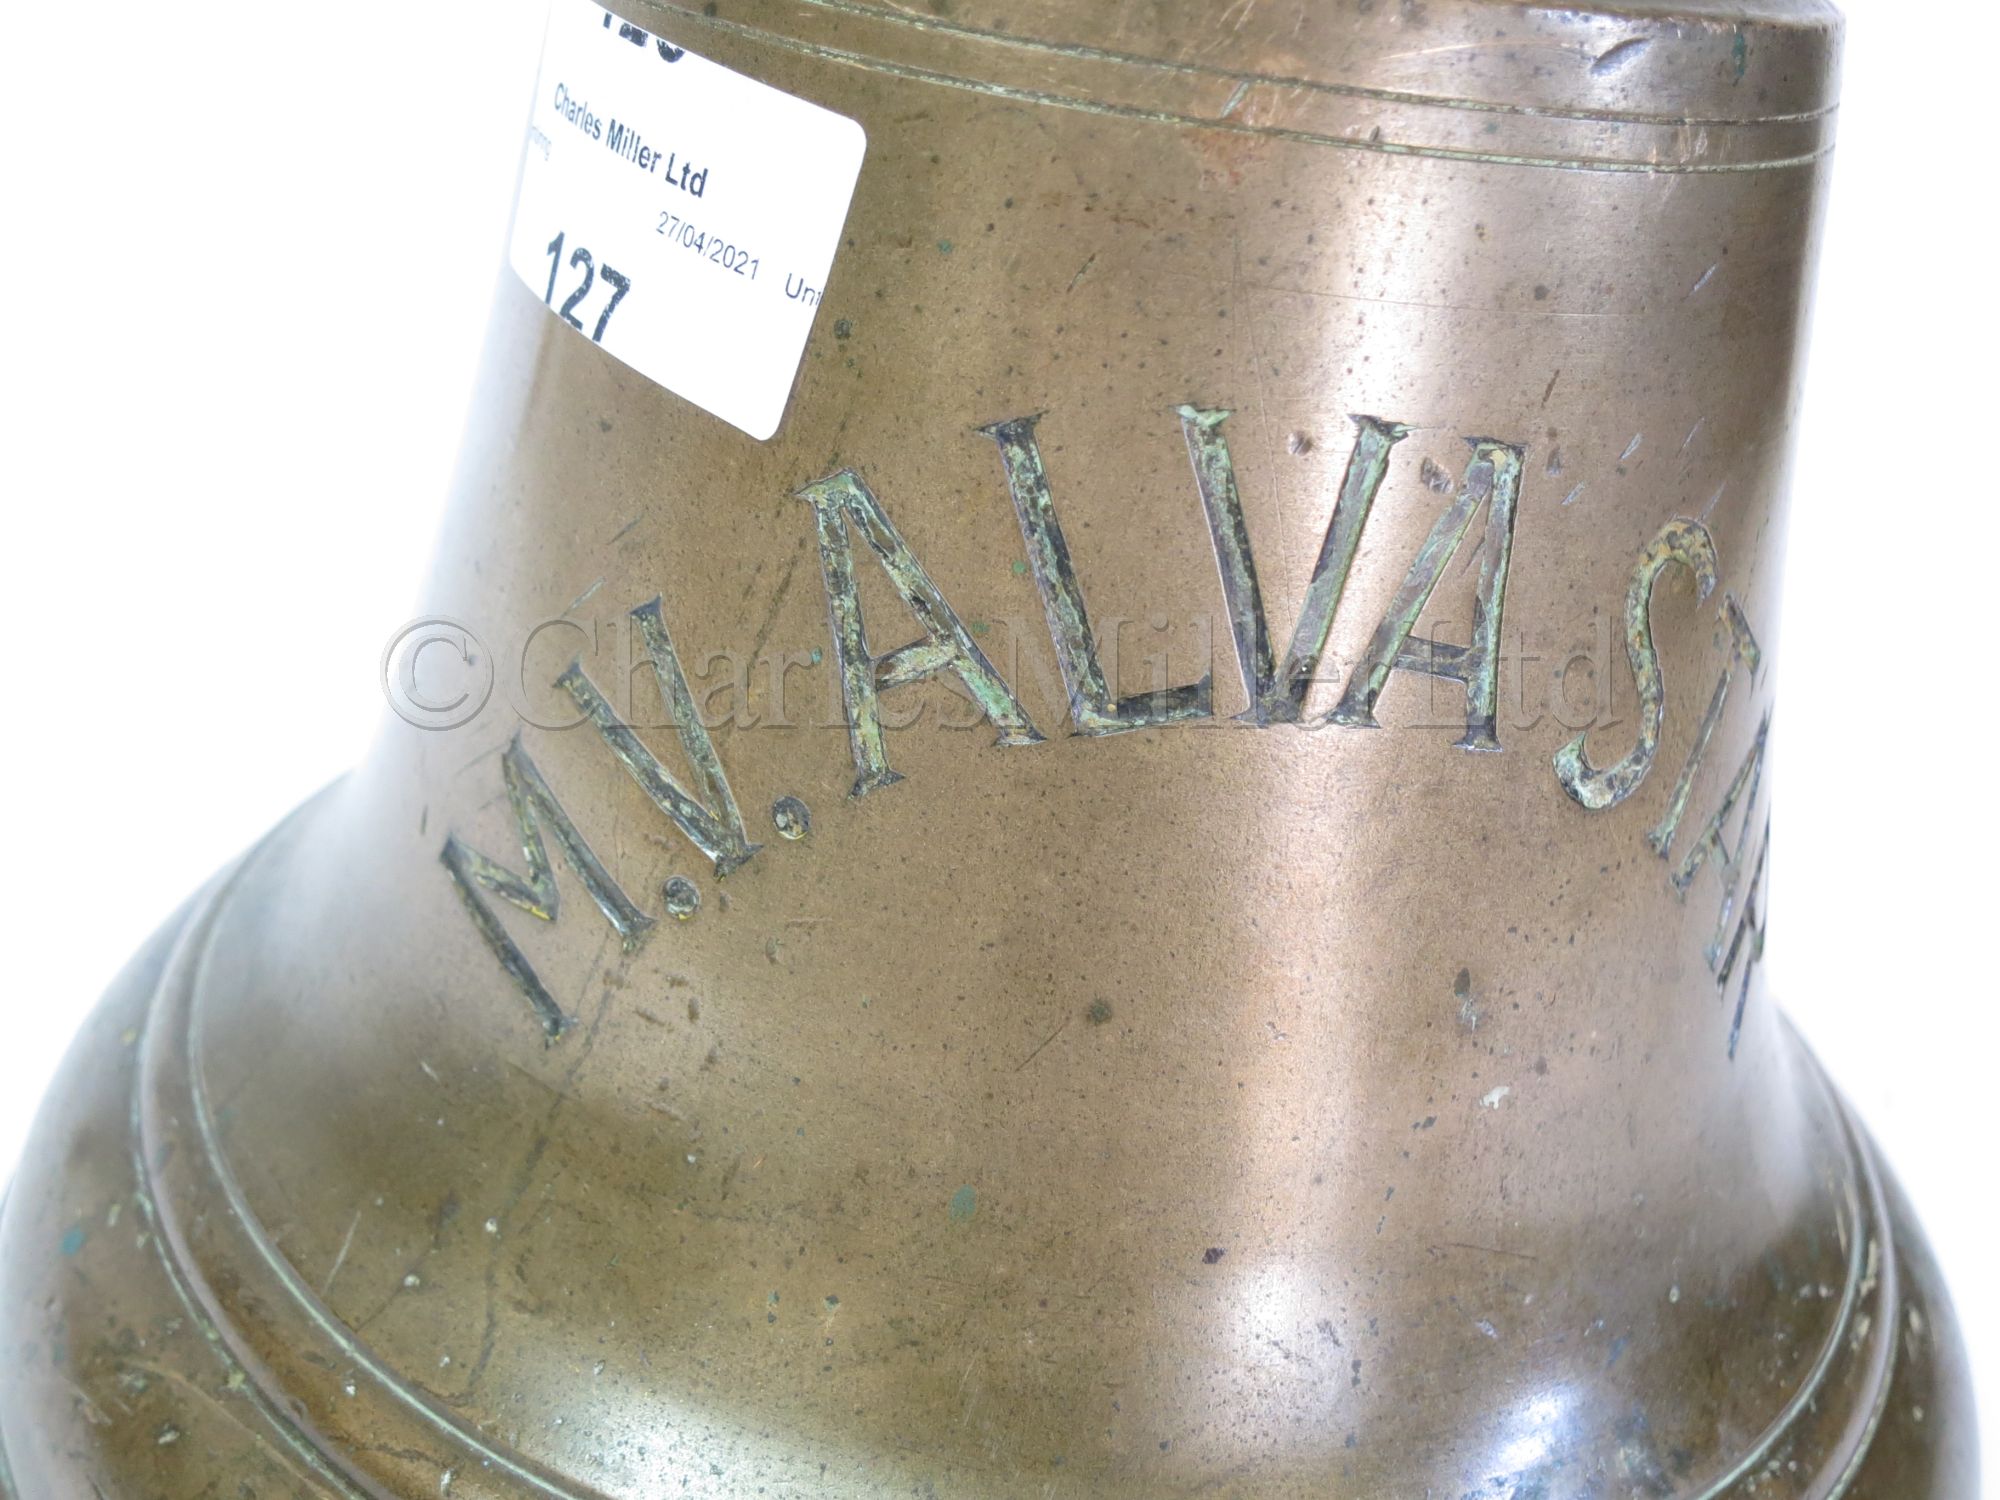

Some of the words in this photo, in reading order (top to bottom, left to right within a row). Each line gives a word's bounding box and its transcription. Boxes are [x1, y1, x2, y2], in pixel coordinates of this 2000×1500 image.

[553, 82, 602, 141] Charles
[605, 118, 662, 174] Miller
[665, 152, 708, 198] Ltd
[544, 231, 631, 342] 127
[656, 211, 760, 280] 27/04/2021
[440, 592, 812, 1050] M.V.
